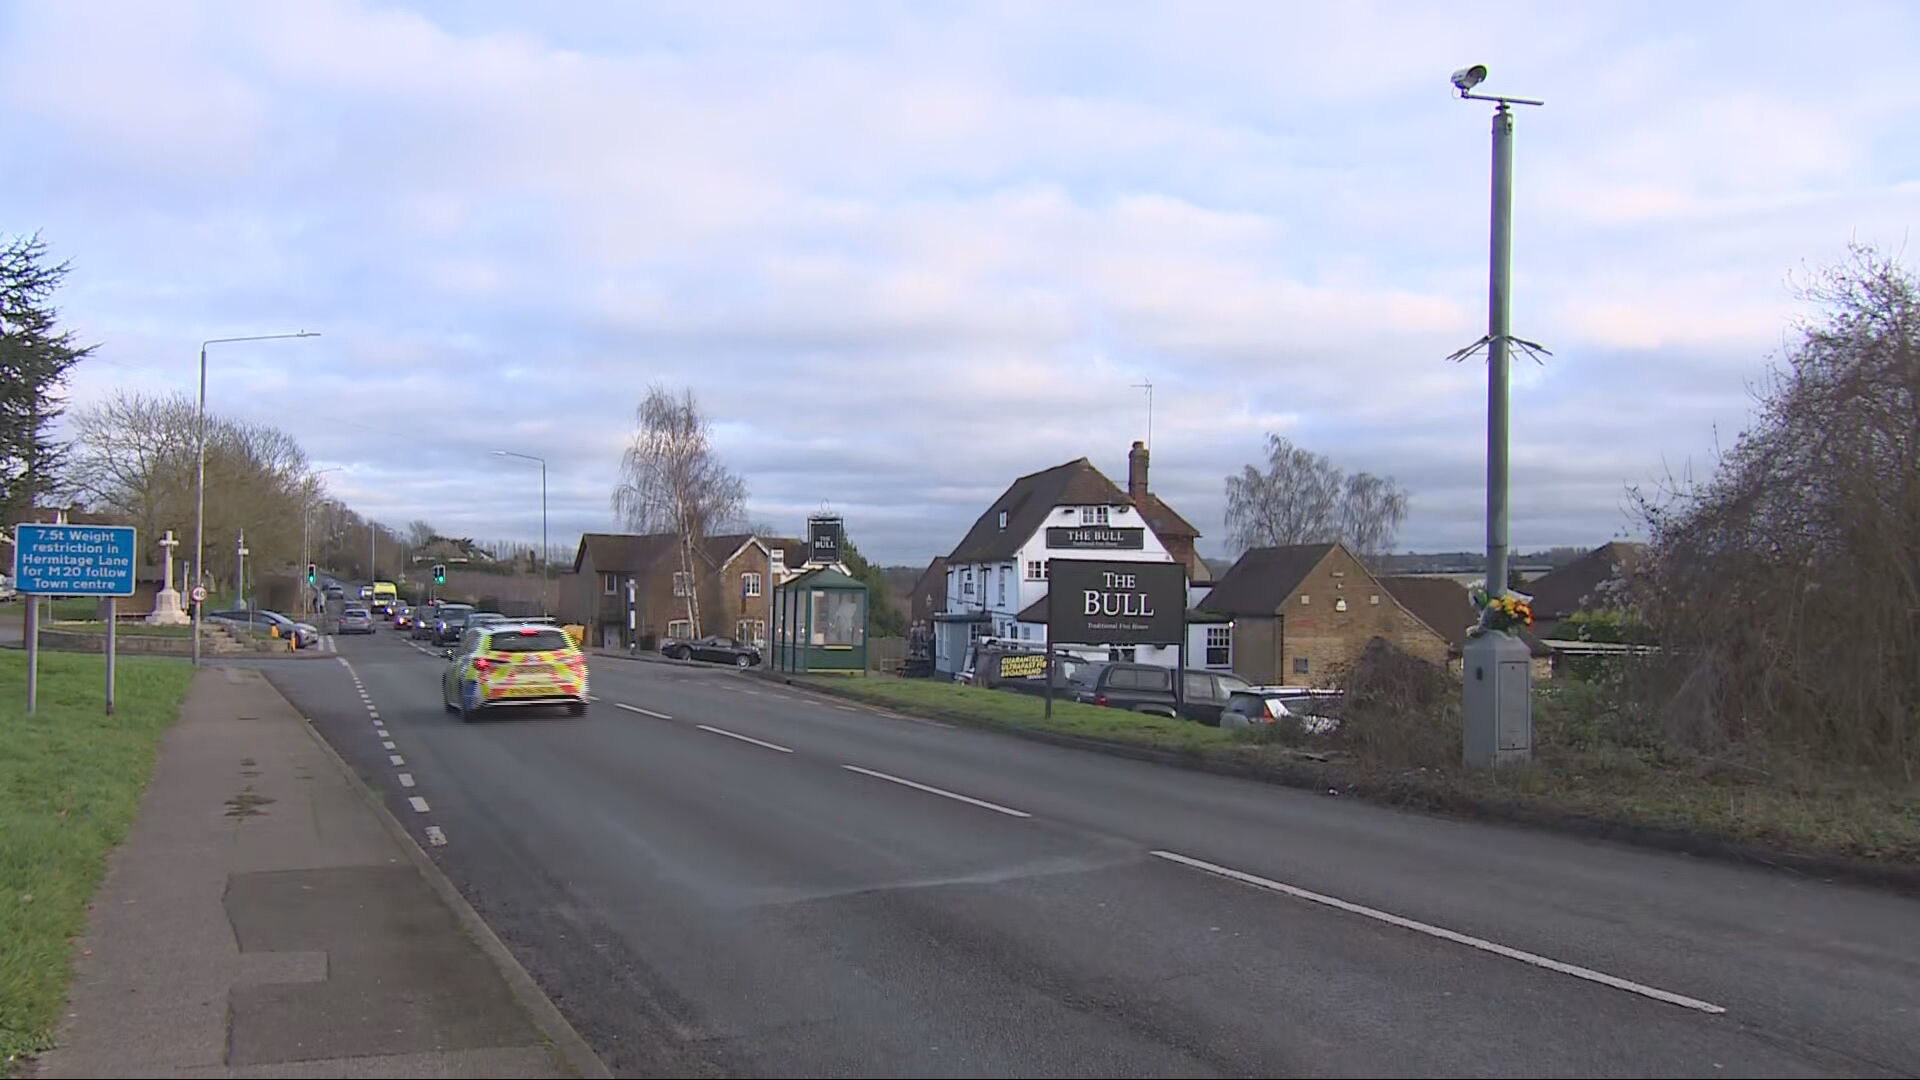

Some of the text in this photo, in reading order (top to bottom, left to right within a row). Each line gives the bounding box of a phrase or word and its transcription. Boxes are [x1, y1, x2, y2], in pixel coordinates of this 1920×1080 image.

[37, 530, 115, 543] 7.5t Weight
[1067, 531, 1124, 541] THE BULL
[32, 543, 119, 554] restriction in
[815, 540, 836, 549] BULL
[22, 554, 129, 567] Hermitage Lane
[22, 566, 43, 577] for
[86, 567, 127, 578] follow
[32, 578, 116, 590] Town centre
[1103, 572, 1136, 588] THE
[1083, 590, 1155, 617] BULL
